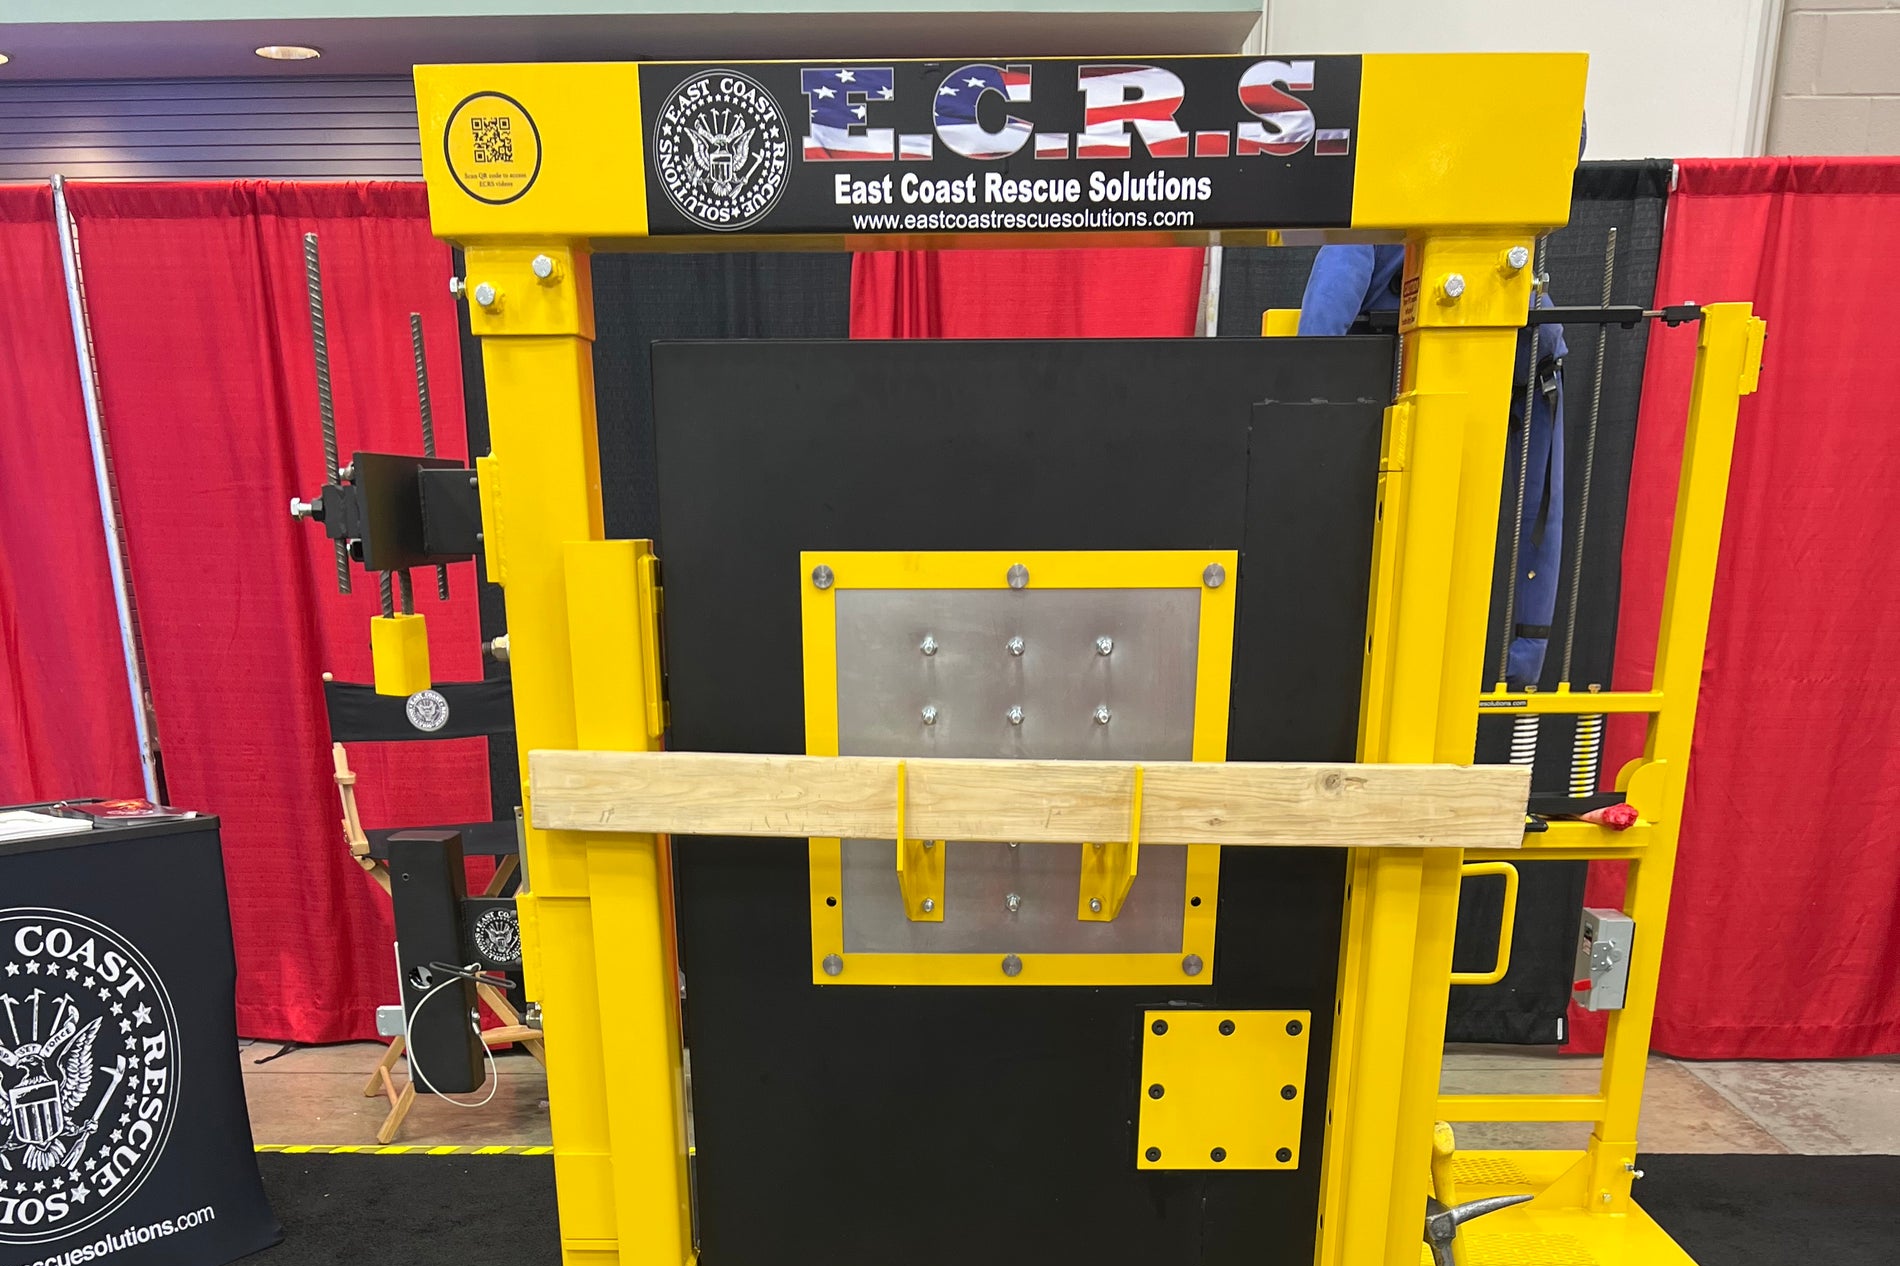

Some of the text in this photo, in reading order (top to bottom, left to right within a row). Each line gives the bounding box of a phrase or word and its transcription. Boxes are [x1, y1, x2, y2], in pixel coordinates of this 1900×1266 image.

[665, 77, 778, 125] EAST COAST
[800, 60, 1351, 162] E.C.R.S.
[478, 172, 488, 181] QR
[659, 138, 731, 223] SOLUTIONS
[741, 141, 787, 218] RESCUE
[834, 170, 1212, 205] East Coast Rescue Solutions
[852, 207, 1195, 230] www.eastcoastrescuesolutions.com
[476, 911, 495, 928] EAST
[14, 924, 147, 999] COAST
[19, 1044, 37, 1056] SET
[44, 1027, 72, 1053] FORCE
[91, 1029, 167, 1199] RESCUE
